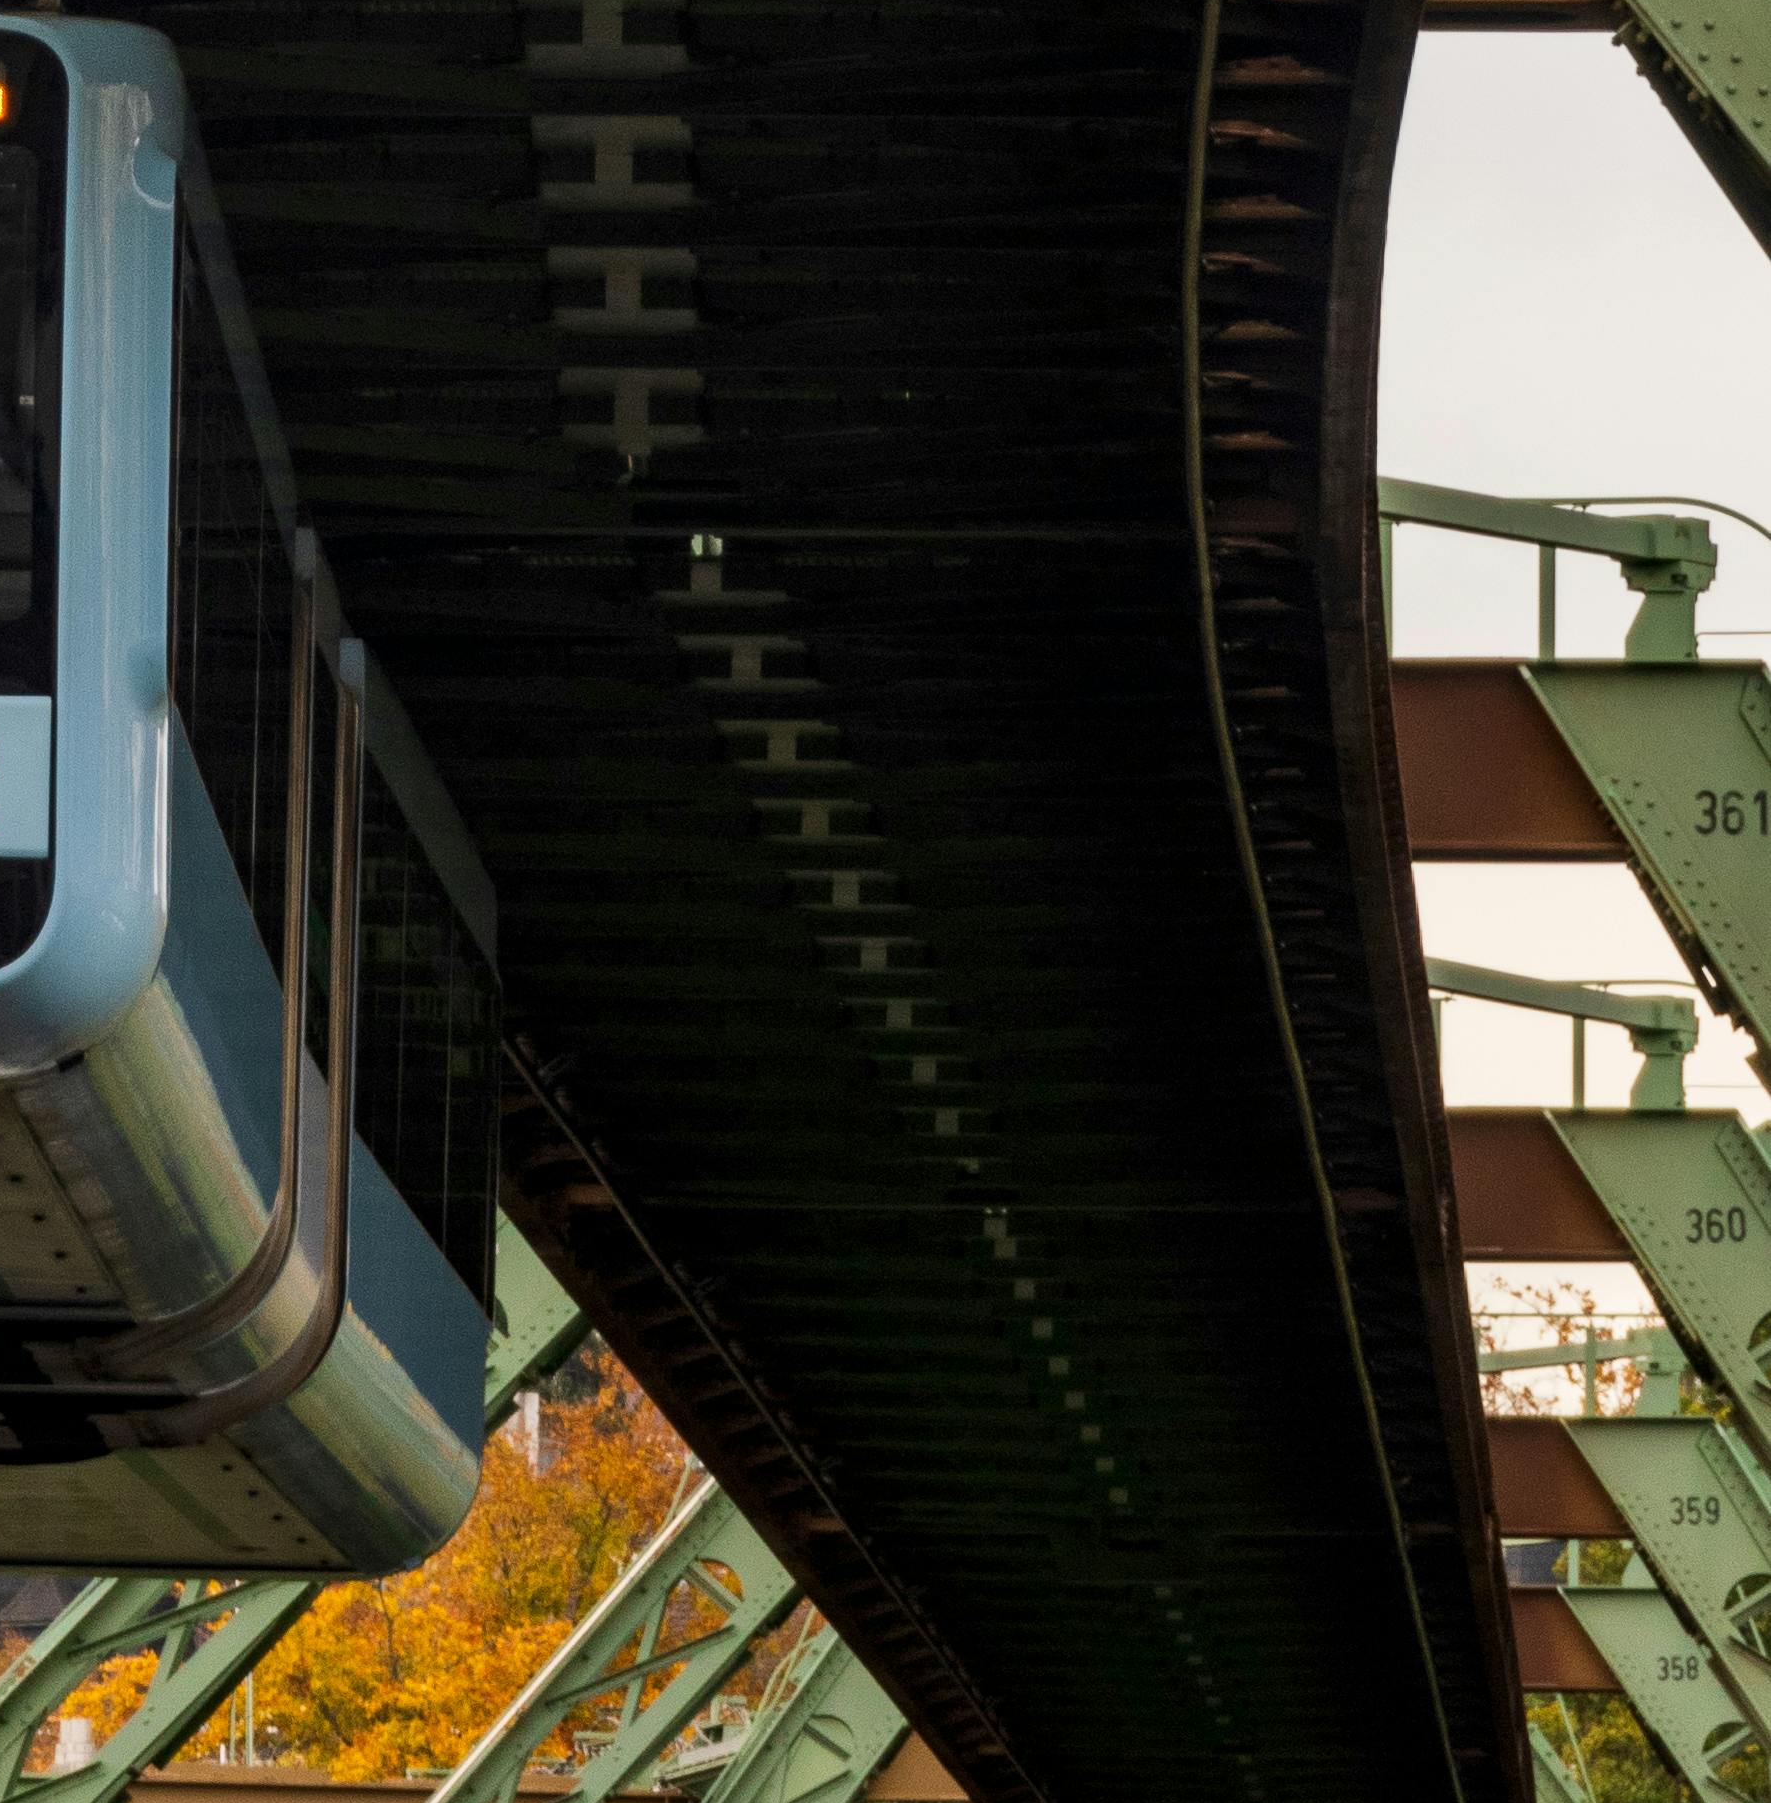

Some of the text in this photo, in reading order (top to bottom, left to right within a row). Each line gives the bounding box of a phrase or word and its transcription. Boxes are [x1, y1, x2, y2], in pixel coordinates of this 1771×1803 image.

[1695, 790, 1768, 835] 361
[1685, 1208, 1746, 1243] 360
[1670, 1496, 1720, 1525] 359
[1657, 1656, 1699, 1681] 358
